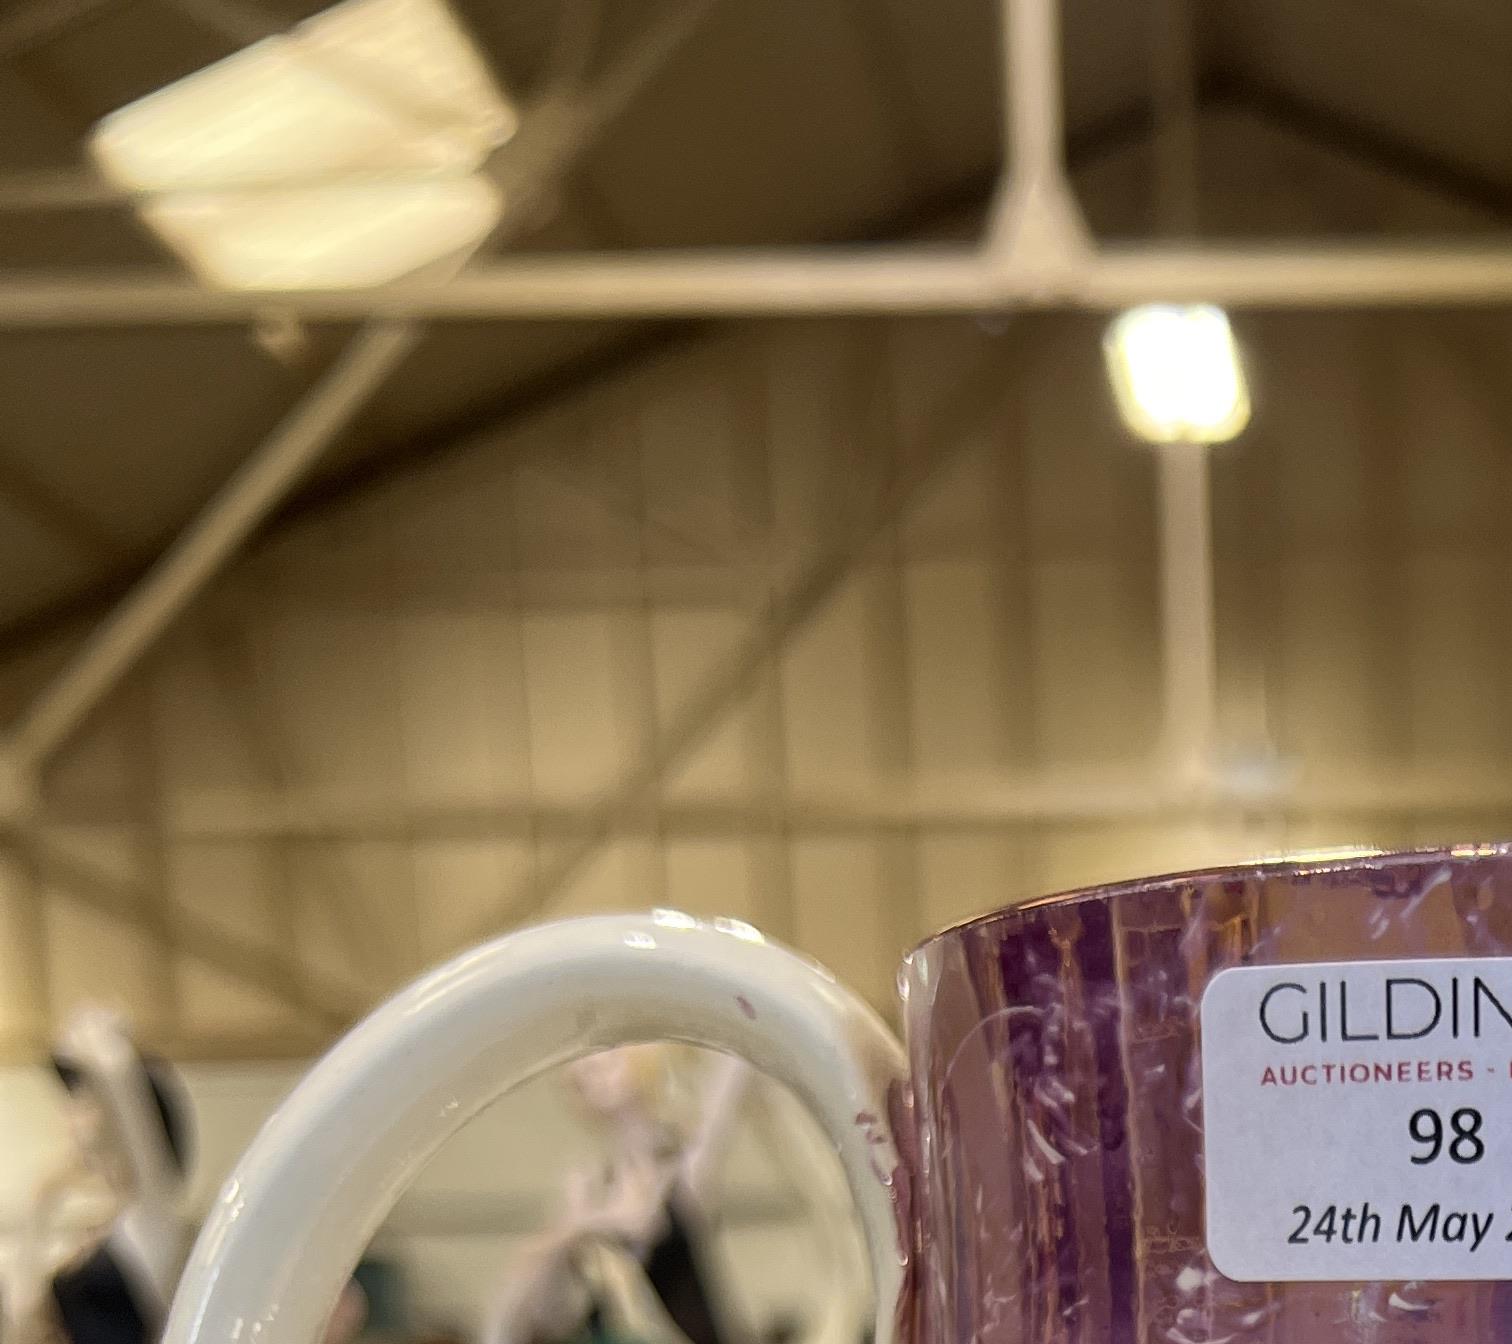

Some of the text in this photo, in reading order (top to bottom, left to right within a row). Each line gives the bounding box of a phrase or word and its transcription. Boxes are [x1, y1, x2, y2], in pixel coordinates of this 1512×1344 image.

[1260, 1059, 1475, 1087] AUCTIONEERS
[1408, 1106, 1486, 1166] 98
[1287, 1202, 1382, 1245] 24th
[1396, 1202, 1495, 1253] May
